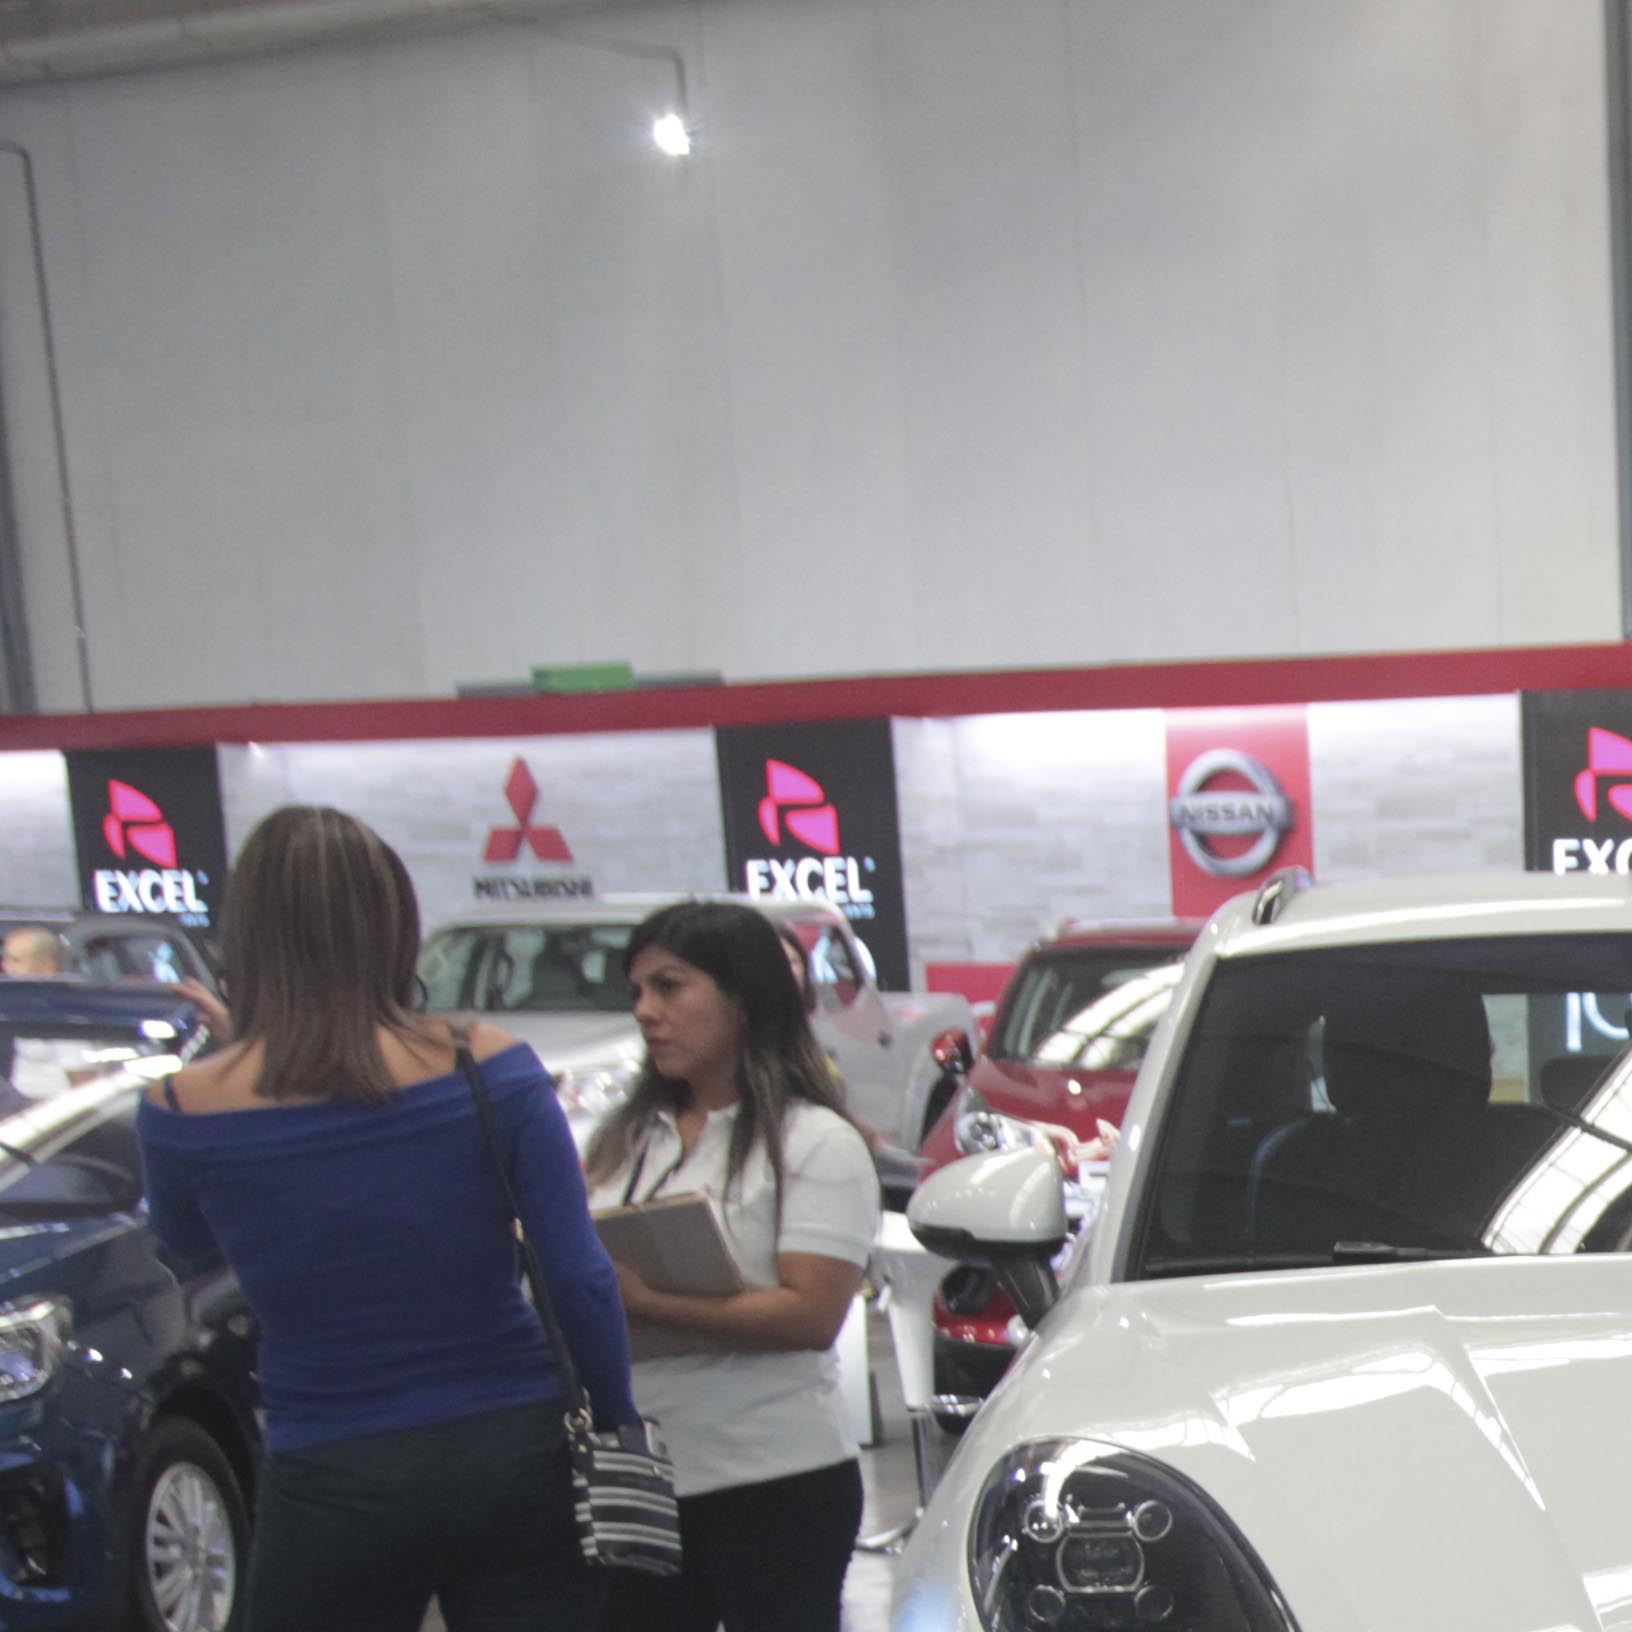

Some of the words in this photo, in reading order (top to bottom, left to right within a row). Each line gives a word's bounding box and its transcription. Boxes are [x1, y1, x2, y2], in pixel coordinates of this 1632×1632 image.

[1178, 803, 1275, 825] NISSAN
[94, 868, 208, 913] EXCEL
[746, 856, 874, 904] EXCEL
